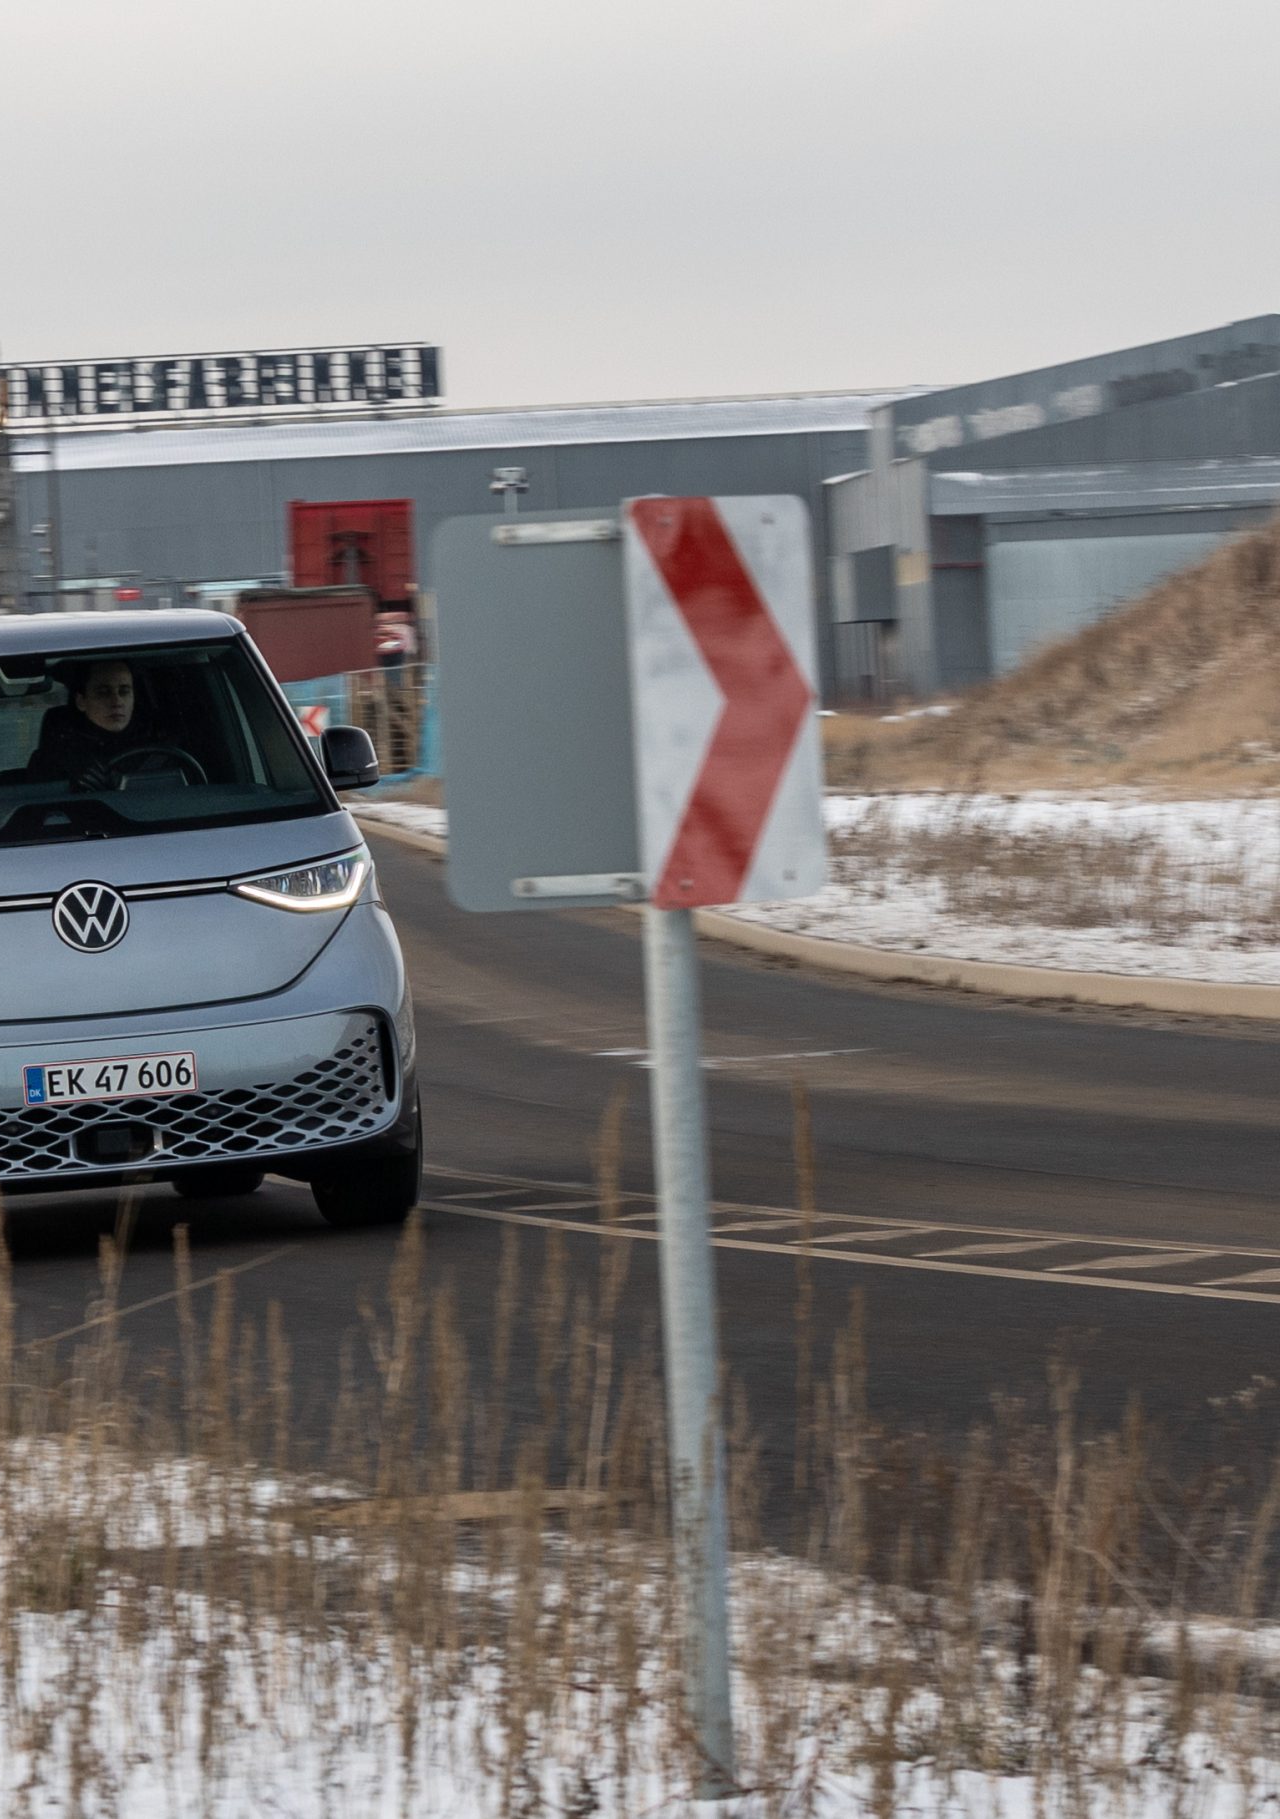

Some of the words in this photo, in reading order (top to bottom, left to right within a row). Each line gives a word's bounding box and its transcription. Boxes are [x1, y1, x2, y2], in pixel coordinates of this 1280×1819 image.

[57, 885, 124, 948] VW
[29, 1088, 42, 1098] DK
[47, 1068, 87, 1097] EK
[95, 1064, 129, 1092] 47
[138, 1058, 192, 1089] 606
